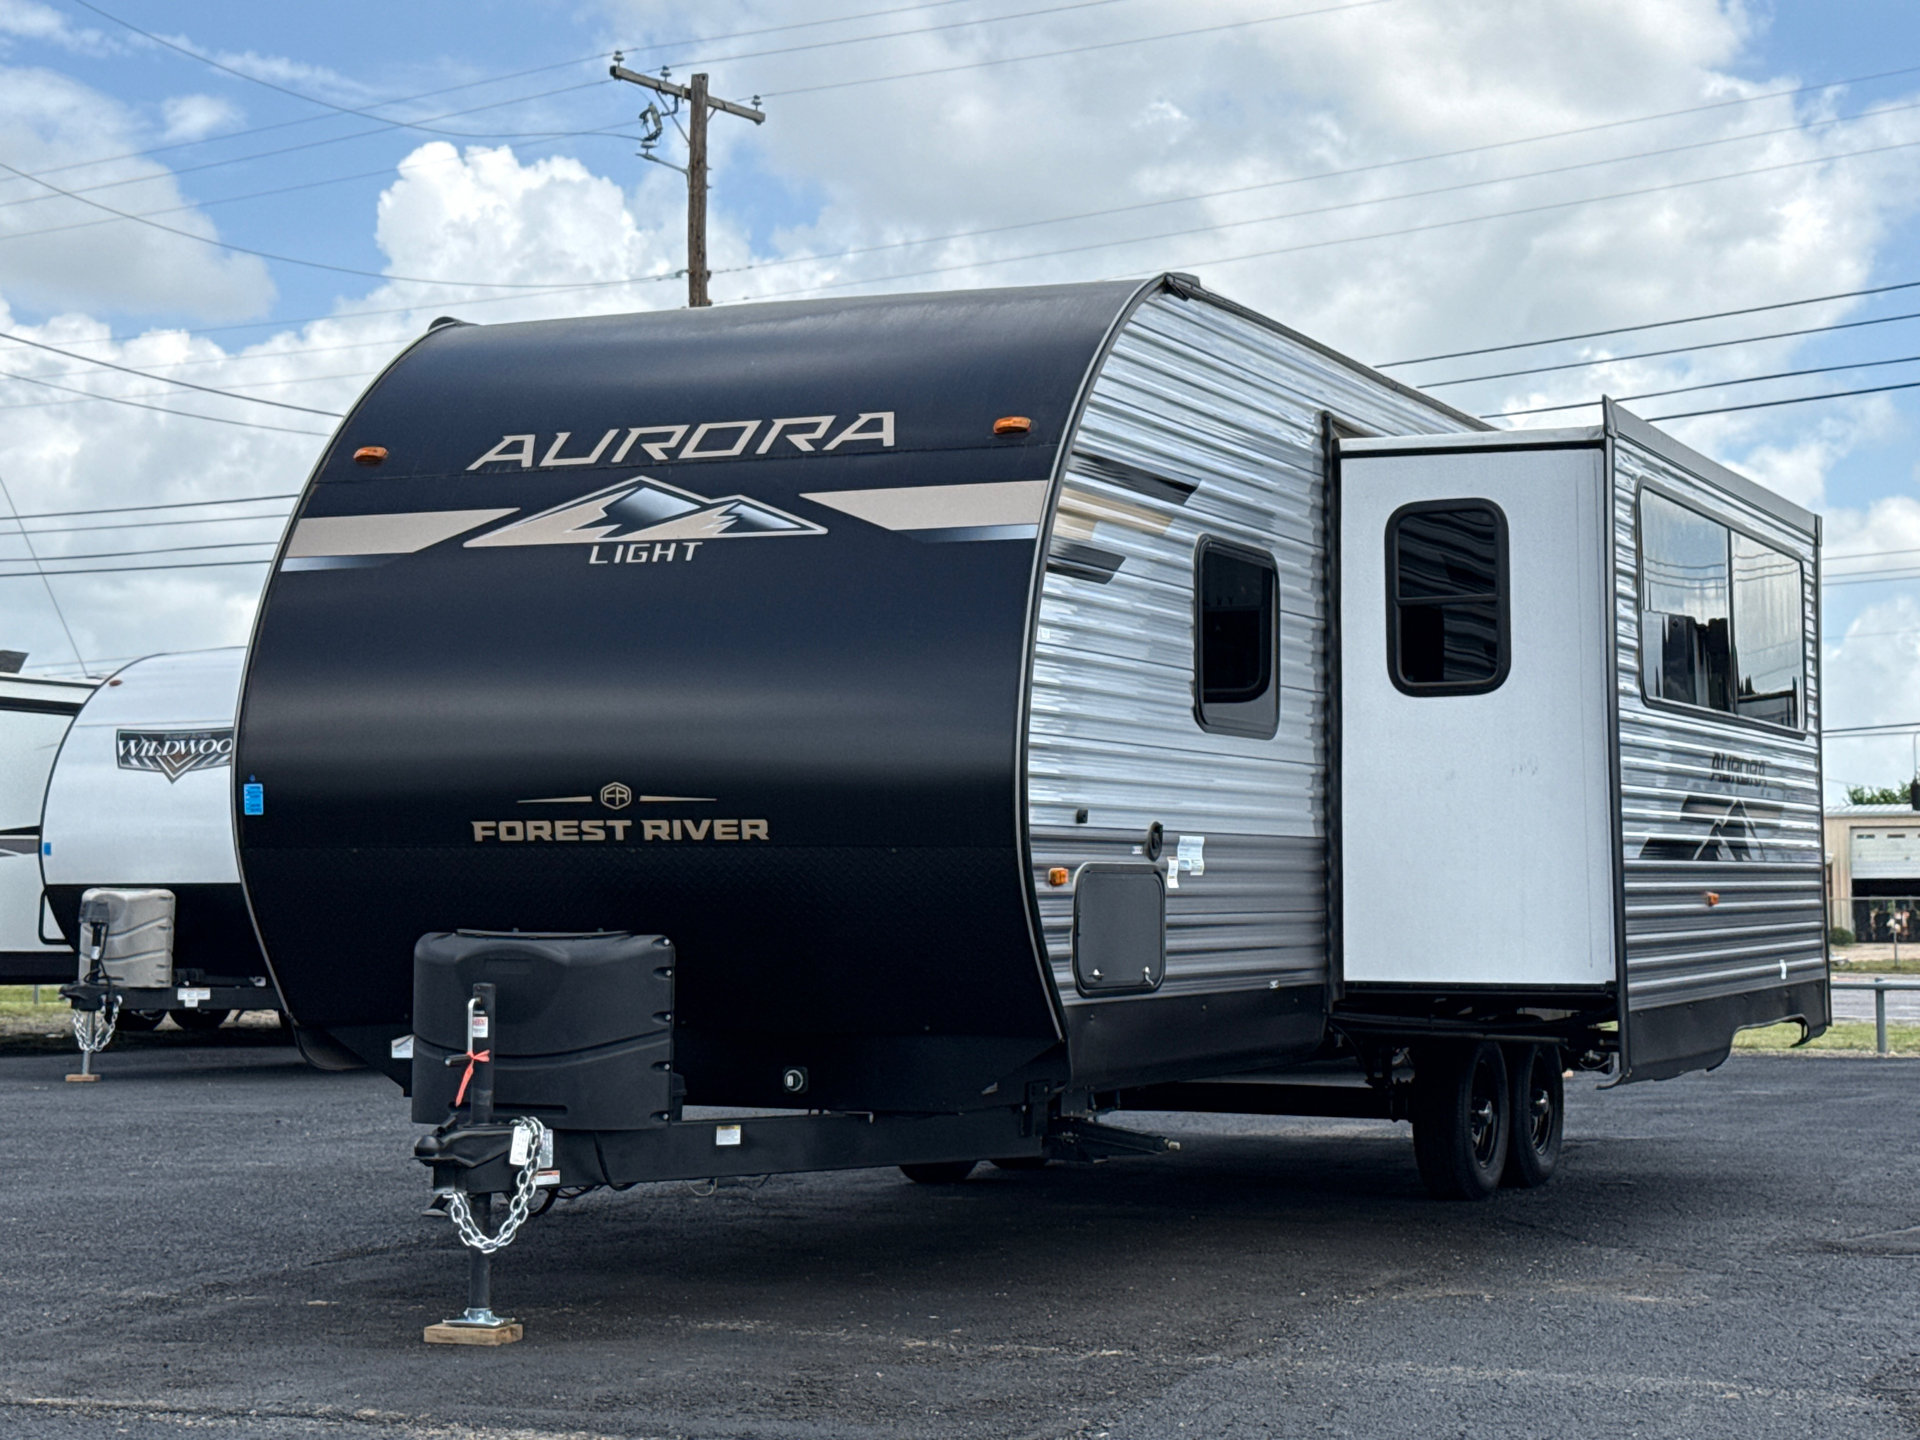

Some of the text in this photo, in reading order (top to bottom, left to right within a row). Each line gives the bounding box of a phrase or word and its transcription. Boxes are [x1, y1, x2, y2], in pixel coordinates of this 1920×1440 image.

[465, 411, 896, 471] AURORA
[589, 541, 703, 564] LIGHT
[471, 819, 770, 842] FOREST RIVER
